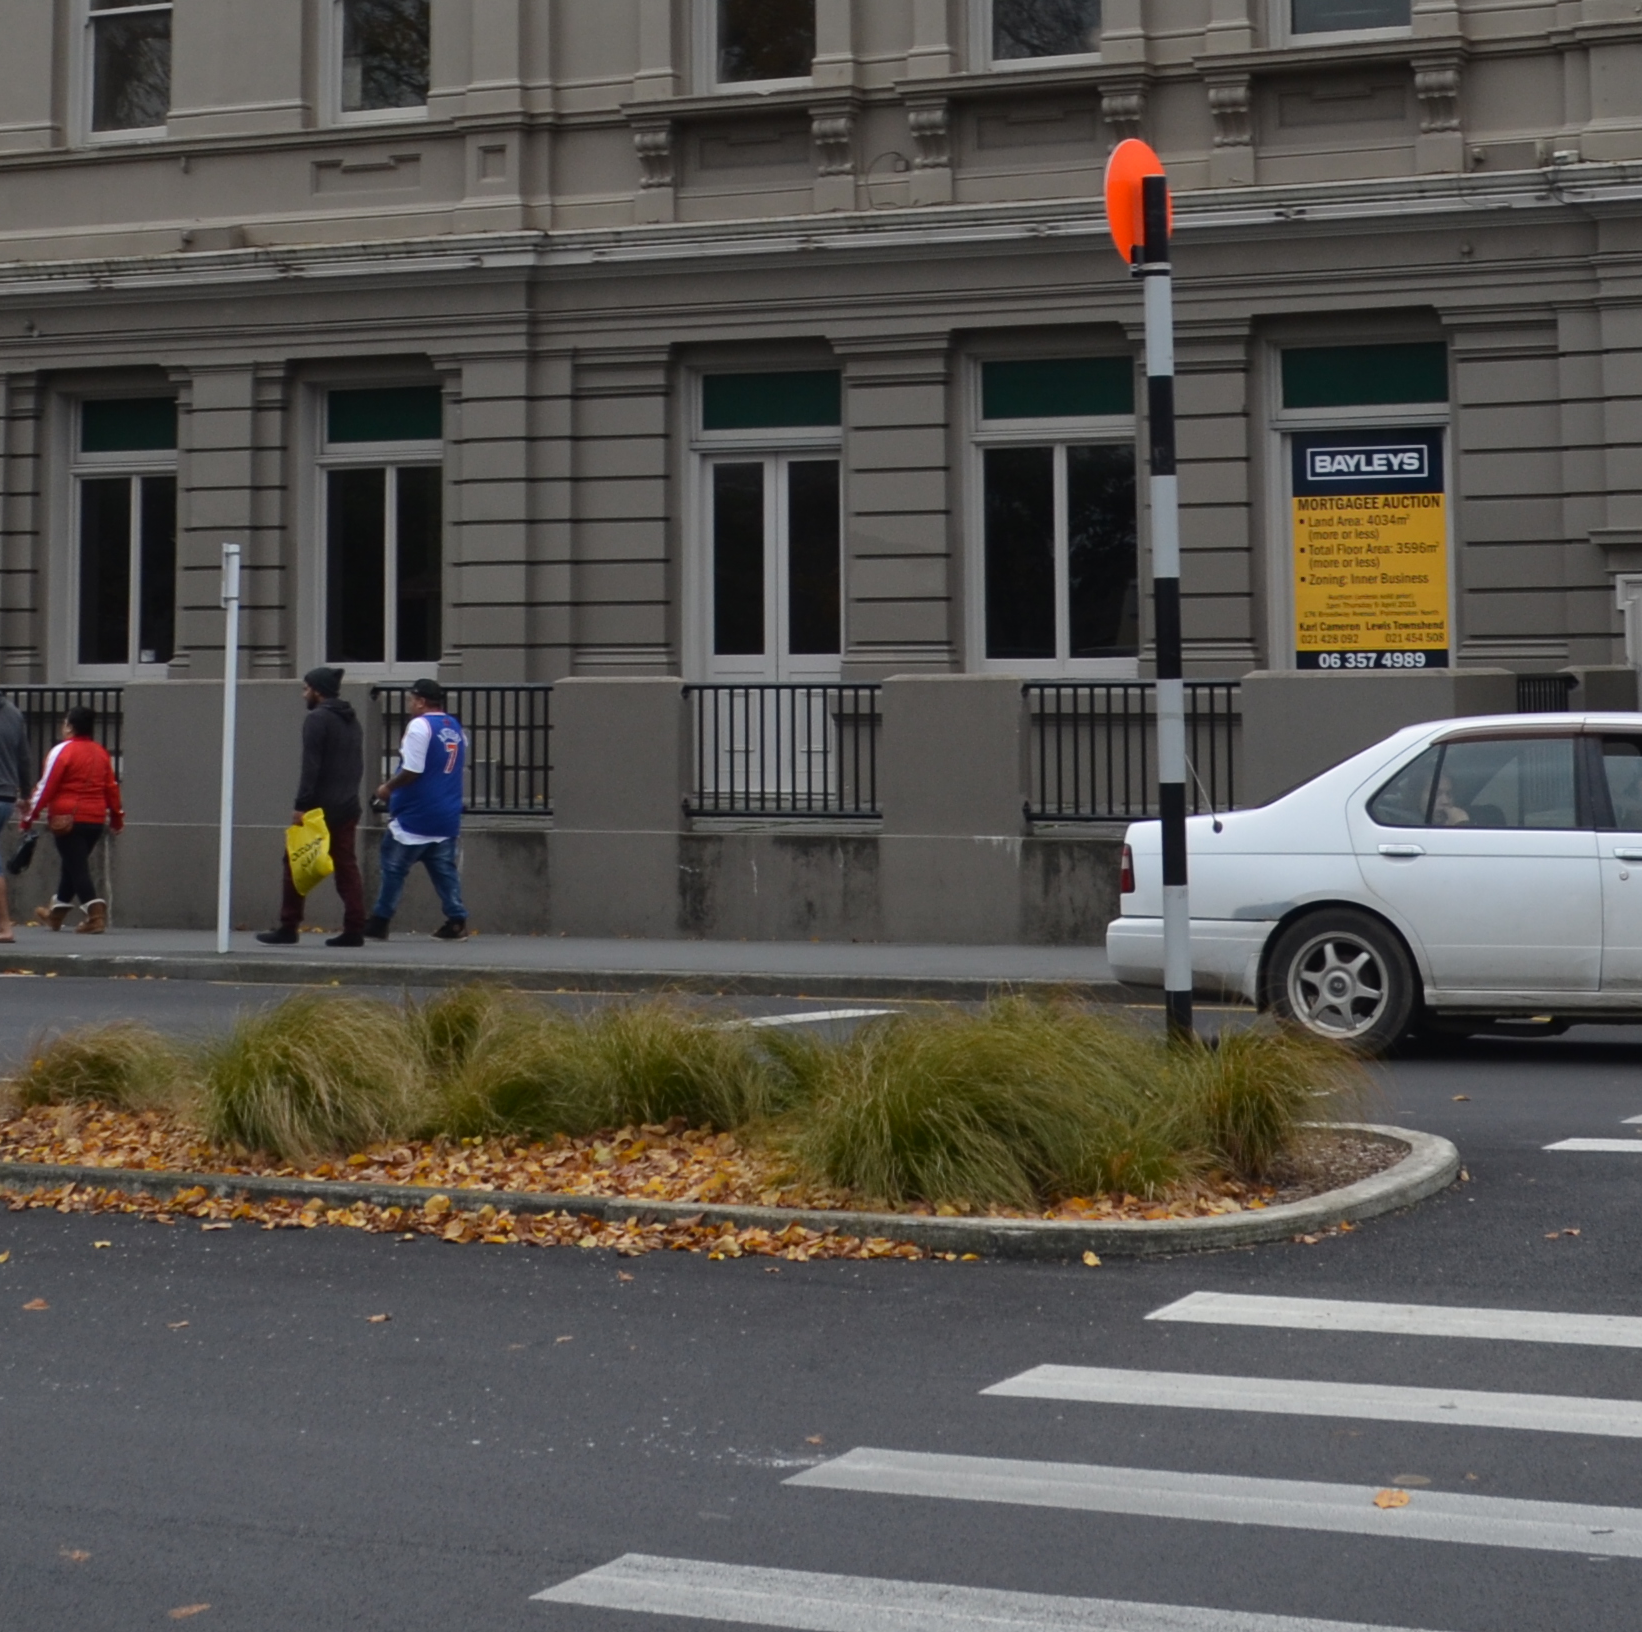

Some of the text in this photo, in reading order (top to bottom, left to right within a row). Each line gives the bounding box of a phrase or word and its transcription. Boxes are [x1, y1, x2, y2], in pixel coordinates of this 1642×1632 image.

[1313, 451, 1421, 474] BAYLEYS
[1298, 494, 1441, 512] MORTGAGEE AUCTION
[1308, 516, 1334, 528] Land
[1336, 515, 1364, 527] Area:
[1308, 528, 1380, 542] (more or less)
[1309, 544, 1334, 556] Total
[1337, 543, 1364, 555] Floor
[1366, 543, 1393, 555] Area:
[1309, 556, 1381, 571] (more or less)
[1308, 572, 1429, 588] Zoning: Inner Business
[1299, 622, 1317, 632] Karl
[1319, 622, 1361, 632] Cameron
[1365, 621, 1391, 631] Lewis
[1301, 634, 1318, 645] 021
[1385, 633, 1402, 643] 021
[1318, 651, 1427, 668] 06 357 4989
[443, 741, 459, 774] 7
